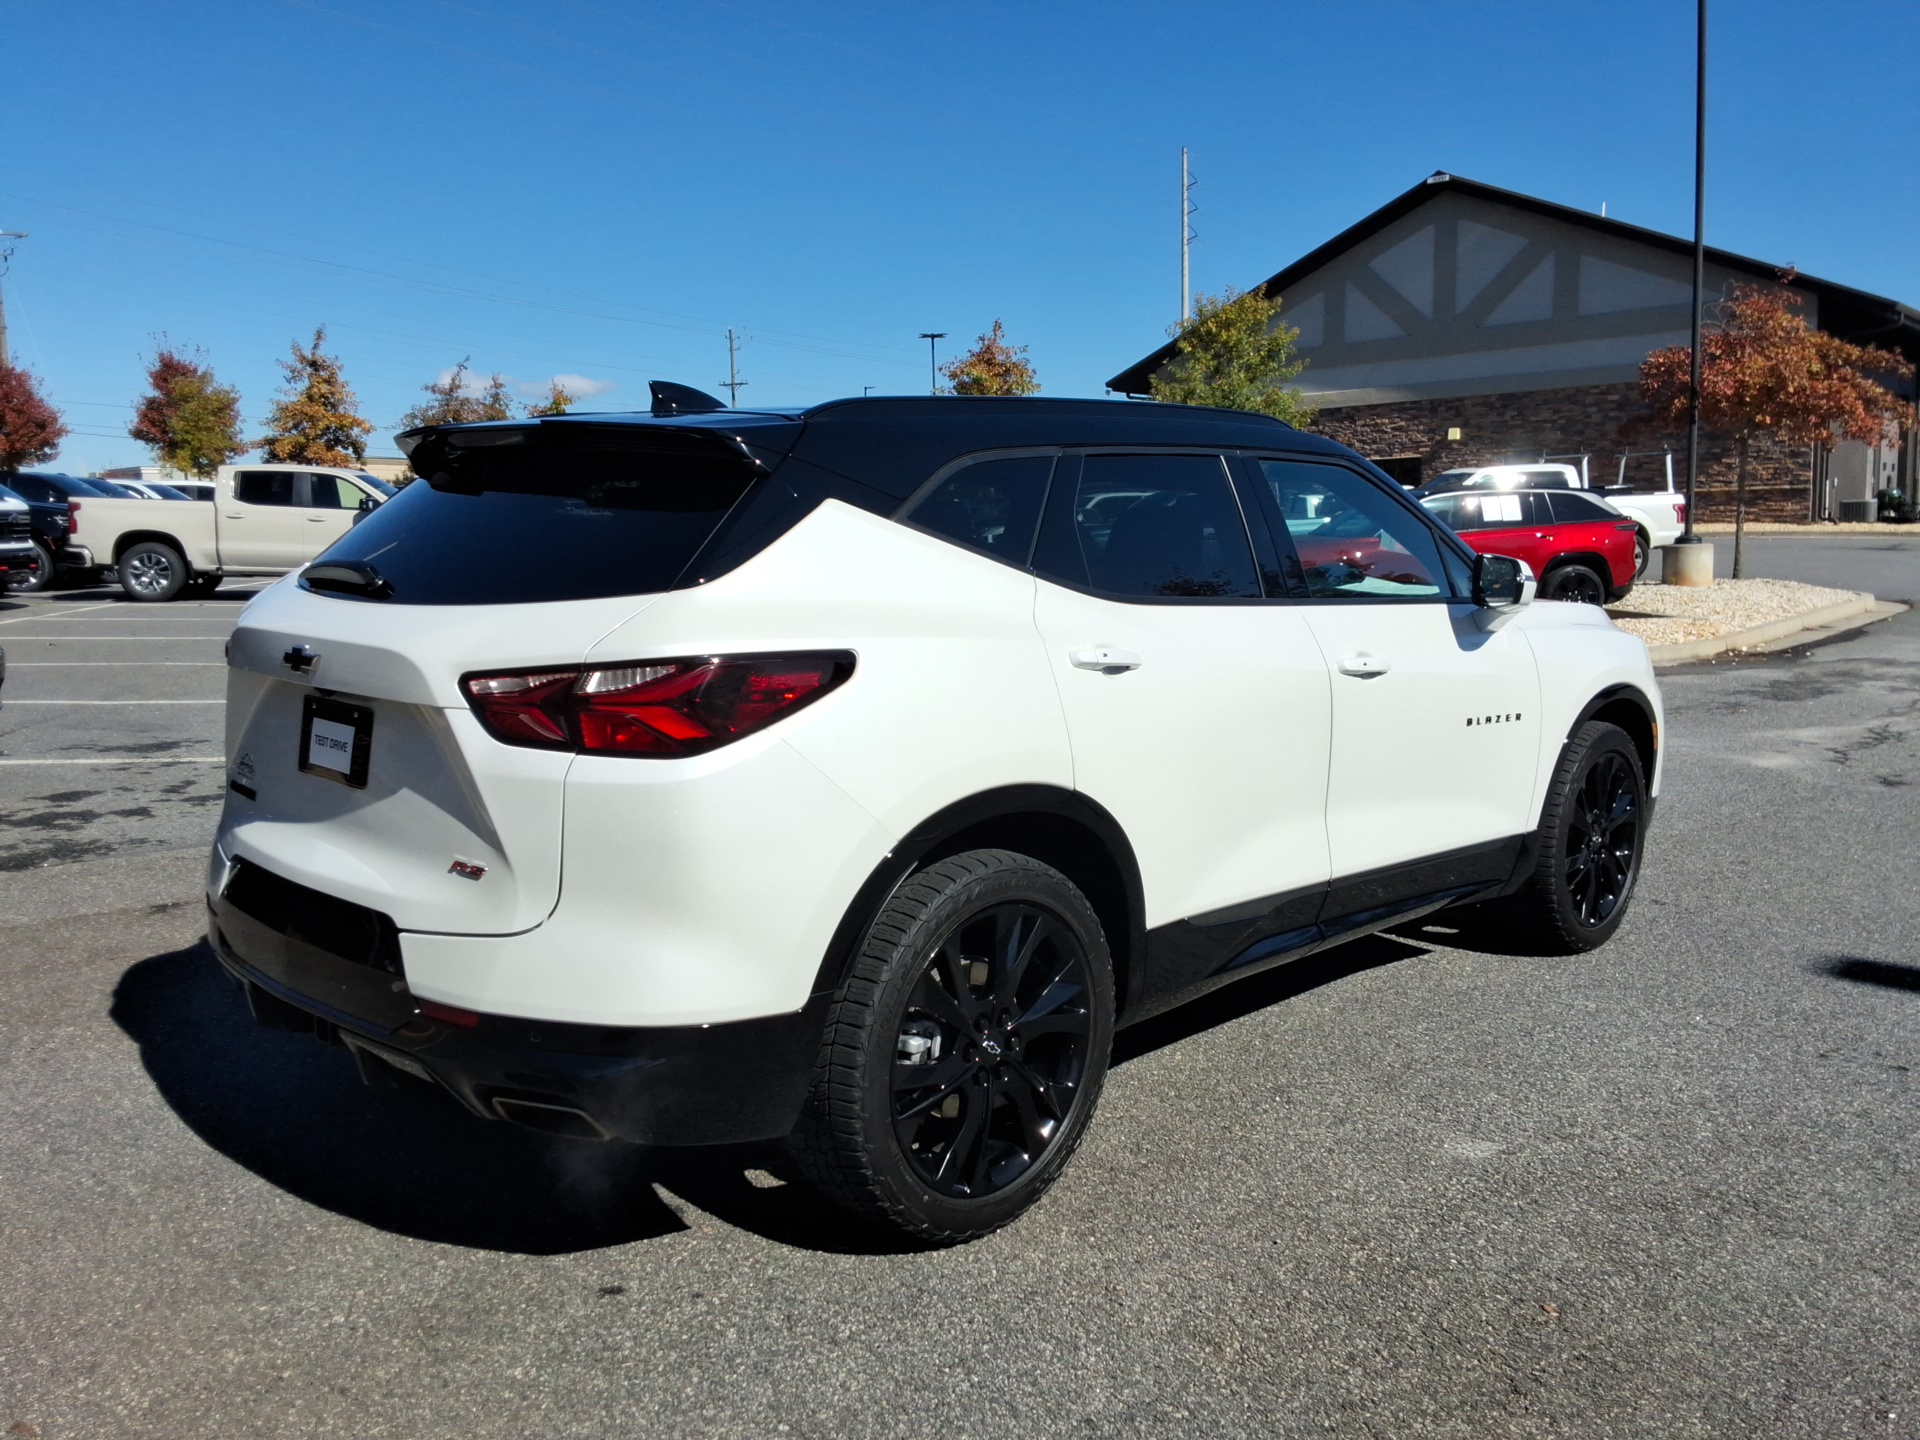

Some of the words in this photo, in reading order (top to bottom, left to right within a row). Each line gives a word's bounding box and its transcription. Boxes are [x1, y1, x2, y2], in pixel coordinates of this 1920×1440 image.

[1466, 713, 1522, 727] BLAZER
[314, 734, 329, 748] TEST
[329, 738, 348, 753] DRIVE
[448, 860, 487, 880] RS
